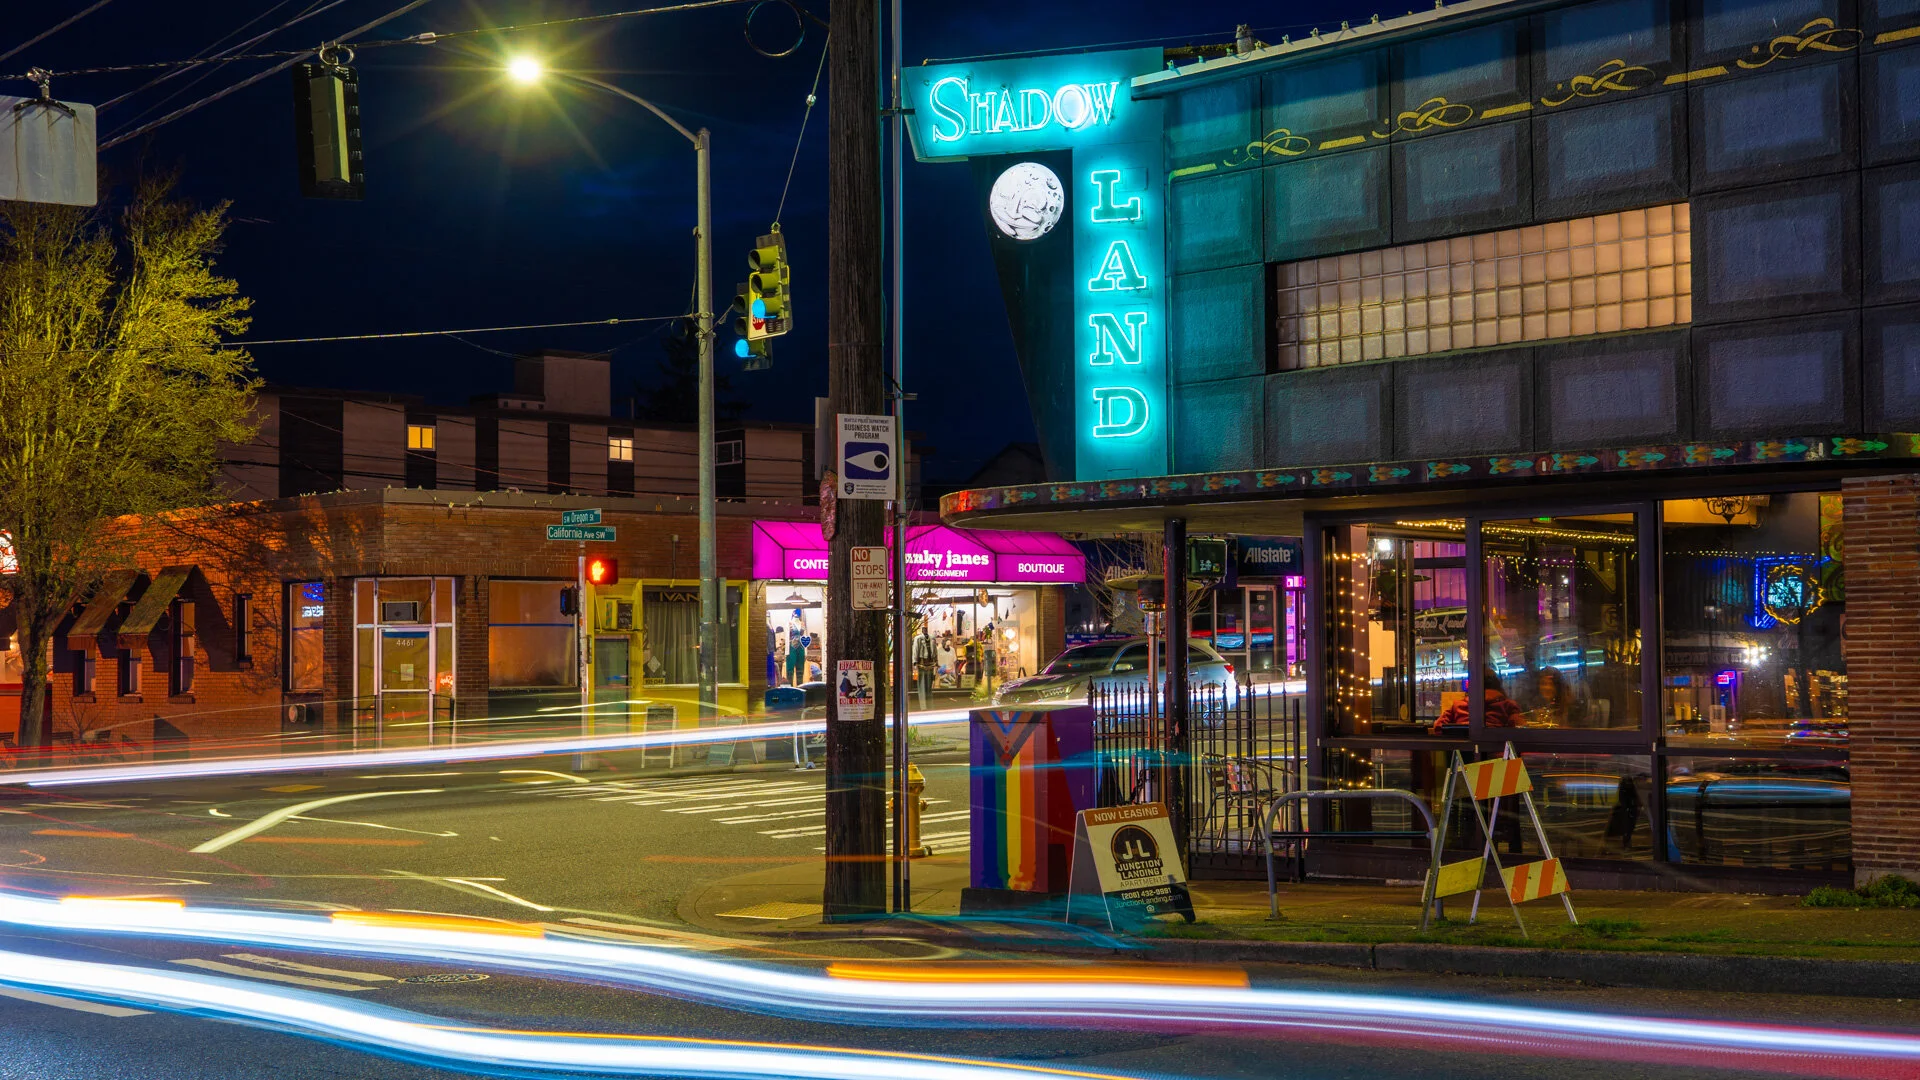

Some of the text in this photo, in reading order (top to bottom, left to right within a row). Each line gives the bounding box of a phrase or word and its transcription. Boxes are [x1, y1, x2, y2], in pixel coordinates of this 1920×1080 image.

[929, 76, 1120, 142] SHADOW
[1087, 169, 1149, 438] LAND
[844, 424, 890, 433] BUSINESS WATCH
[854, 432, 880, 440] PROGRAM
[570, 512, 589, 524] Oregon
[548, 526, 606, 539] California Ave SW
[854, 549, 868, 561] NO
[905, 550, 989, 568] unky janes
[1244, 547, 1291, 564] Allstate
[793, 558, 829, 570] CONTE
[855, 564, 885, 575] STOPS
[1018, 563, 1065, 574] BOUTIQUE
[917, 568, 969, 577] CONSIGNMENT
[856, 582, 884, 590] TOW-AWAY
[862, 590, 879, 599] ZONE
[396, 639, 414, 647] 4461
[1094, 806, 1159, 823] NOW LEASING
[1122, 839, 1151, 860] JL
[1117, 859, 1161, 872] JUNCTION
[1121, 867, 1160, 880] LANDING
[1120, 875, 1168, 888] APARTMENTS
